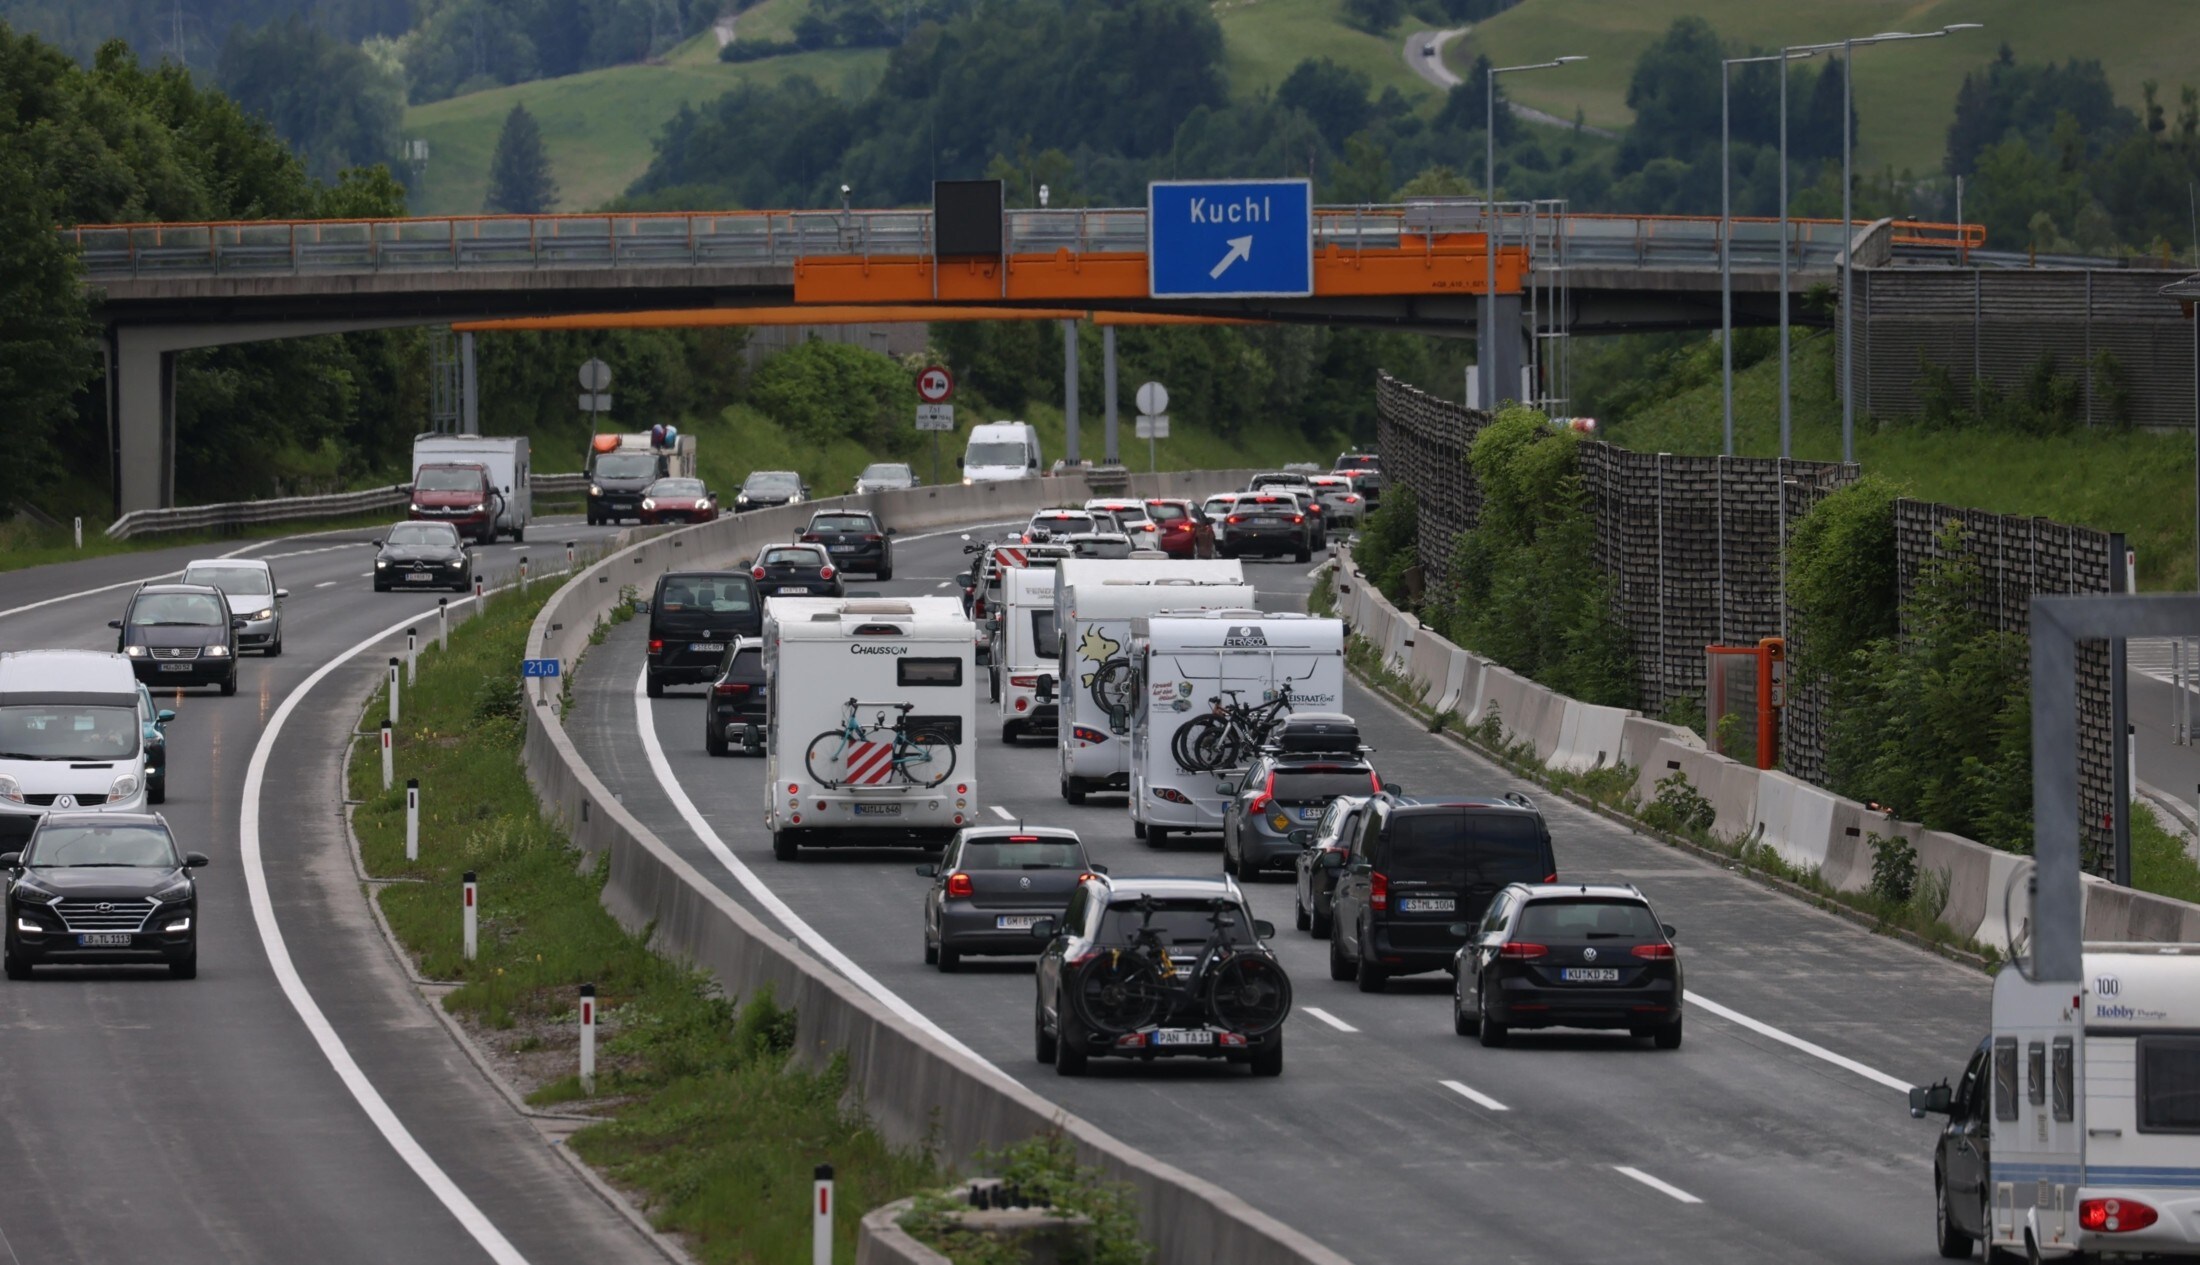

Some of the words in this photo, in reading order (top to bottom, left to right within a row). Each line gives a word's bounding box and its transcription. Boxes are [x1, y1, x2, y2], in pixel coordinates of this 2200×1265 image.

[1190, 196, 1270, 223] Kuchl
[850, 643, 908, 655] CHAUSSON
[528, 661, 554, 676] 21,0
[84, 935, 94, 944] LB
[111, 934, 131, 944] 1113
[1568, 969, 1581, 979] KU
[1602, 969, 1615, 979] 25
[2096, 978, 2119, 995] 100
[2096, 1004, 2135, 1021] Hobby
[1160, 1032, 1179, 1043] PAN
